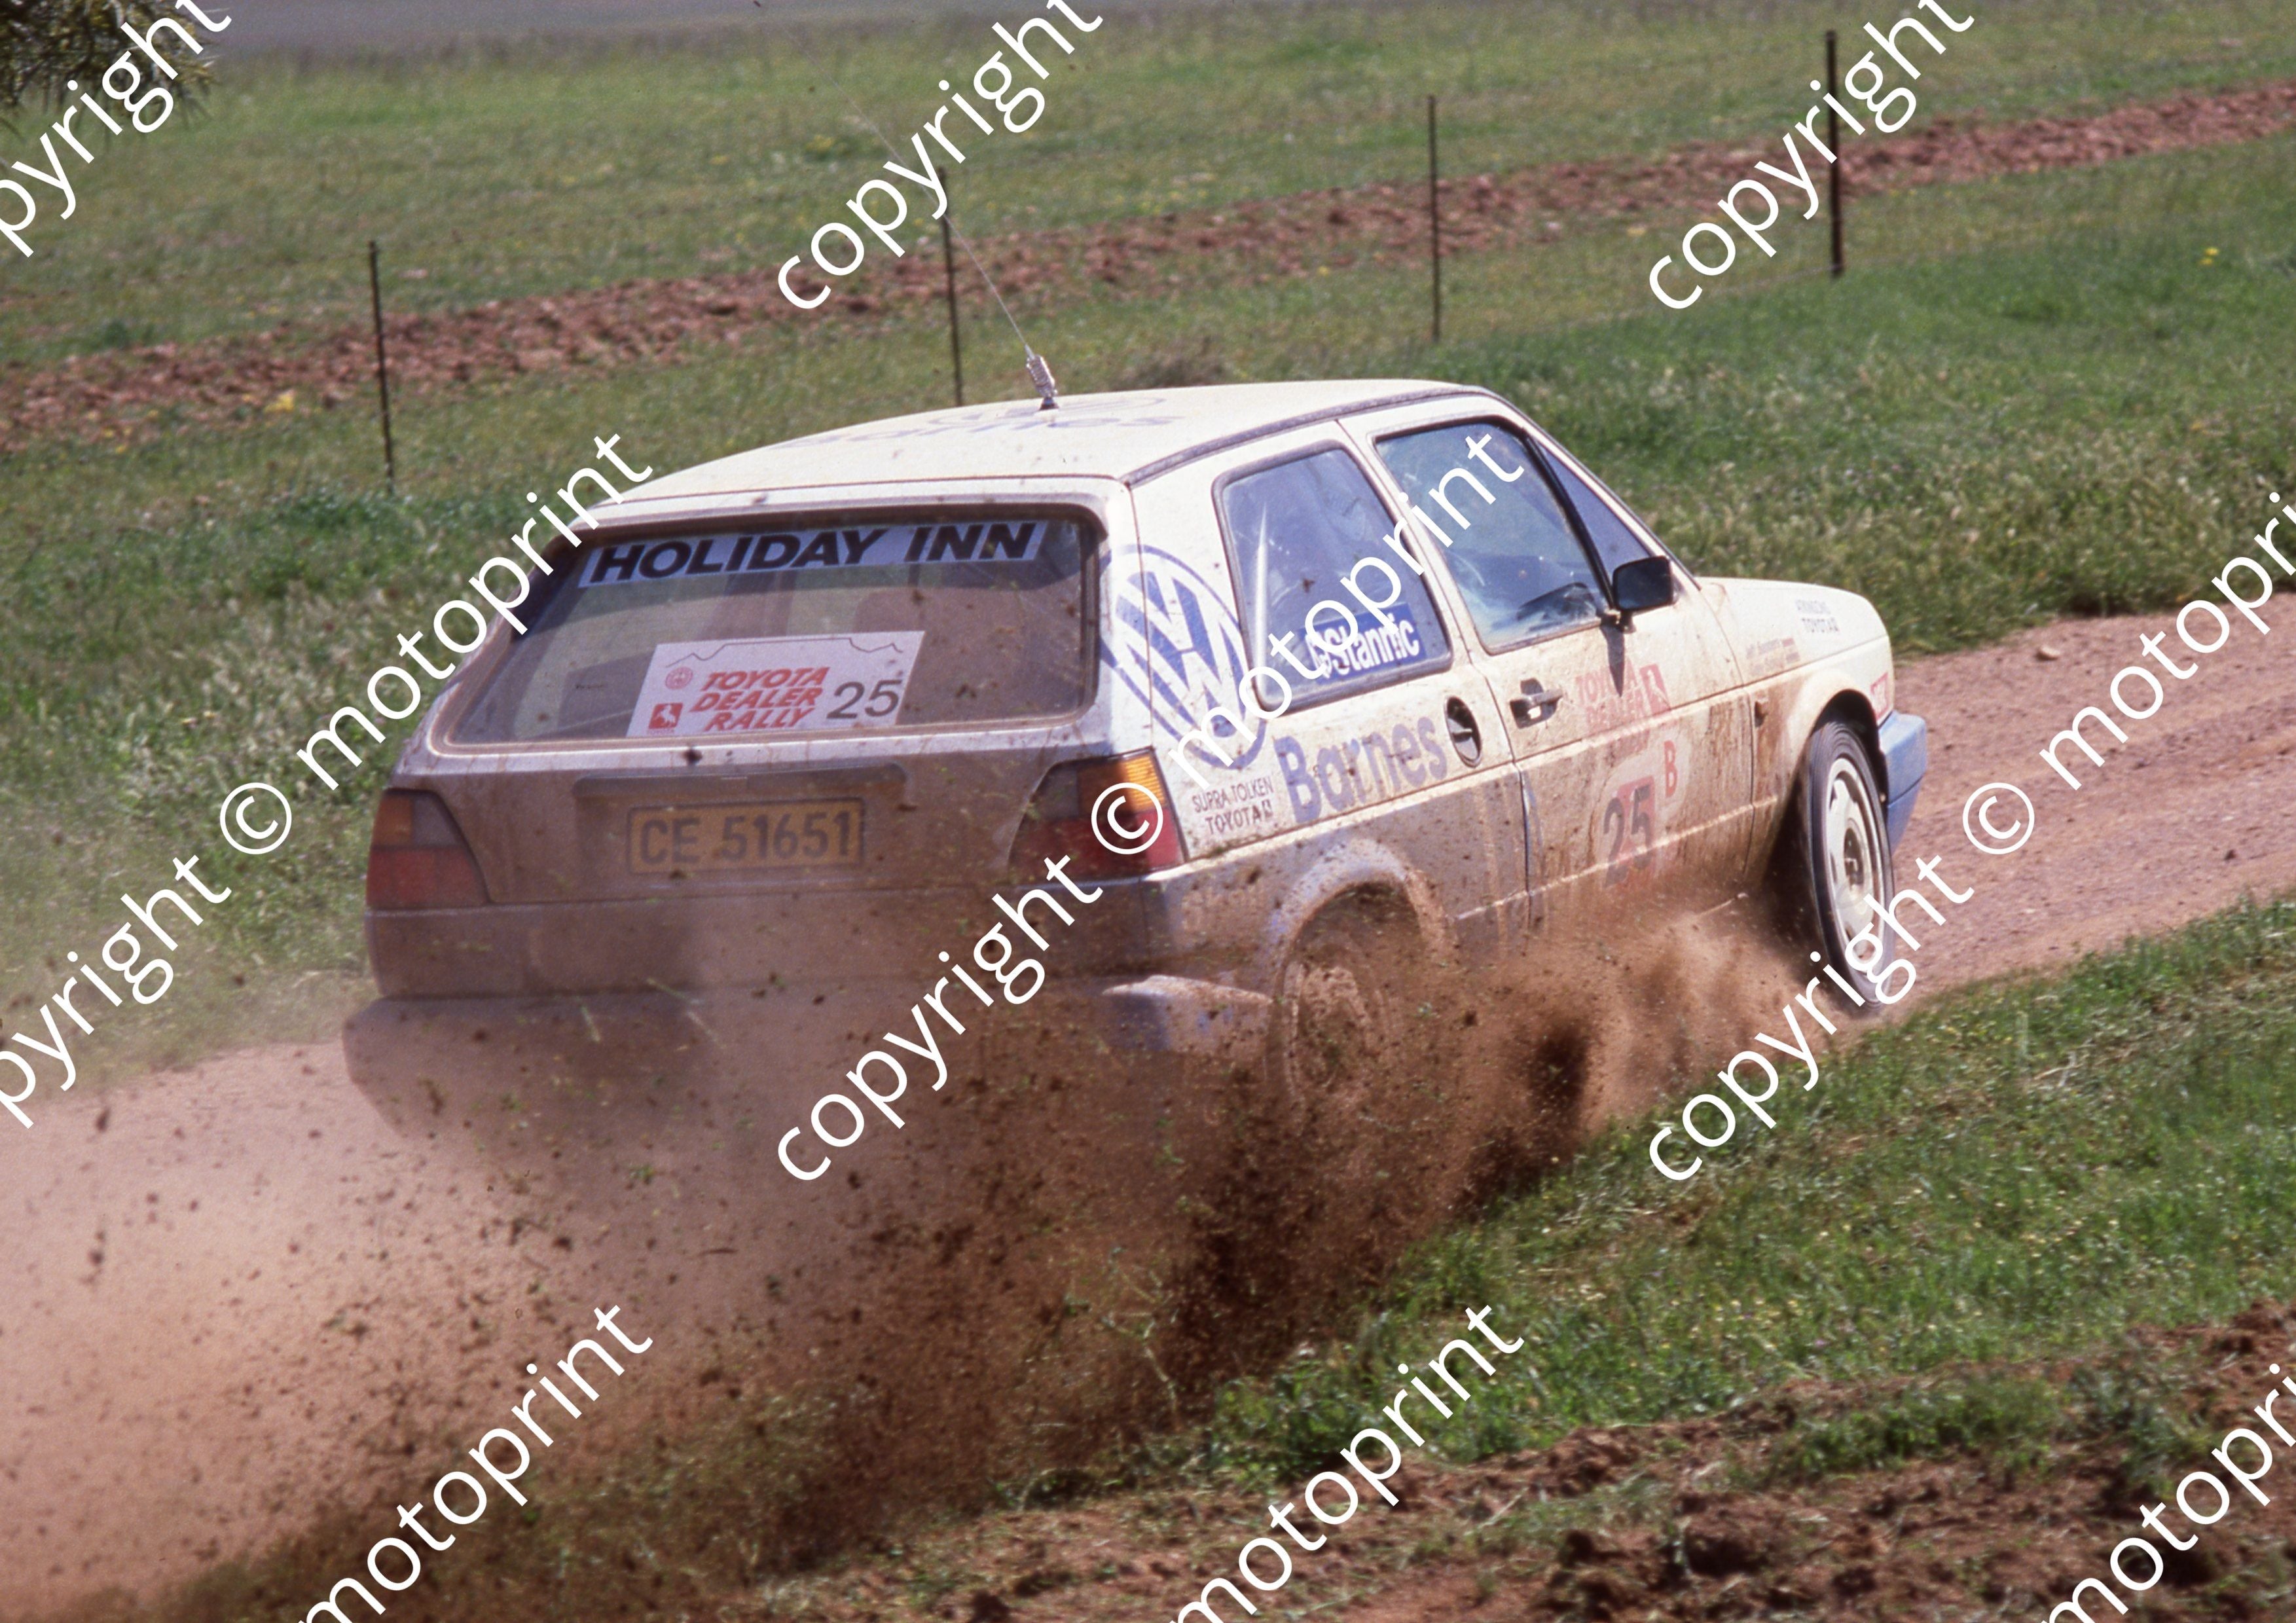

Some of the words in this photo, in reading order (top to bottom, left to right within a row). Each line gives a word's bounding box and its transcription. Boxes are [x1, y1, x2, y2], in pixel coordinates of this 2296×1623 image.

[590, 528, 888, 583] HOLIDAY
[905, 522, 1038, 562] INN
[689, 687, 824, 712] DEALER
[700, 667, 830, 691] TOYOTA
[826, 679, 903, 720] 25
[702, 707, 815, 732] RALLY
[1273, 717, 1447, 824] Barnes
[1664, 740, 1678, 797] B
[640, 816, 701, 864] CE
[721, 810, 852, 862] 51651
[1205, 805, 1262, 835] TOYOTA
[1603, 784, 1653, 888] 25
